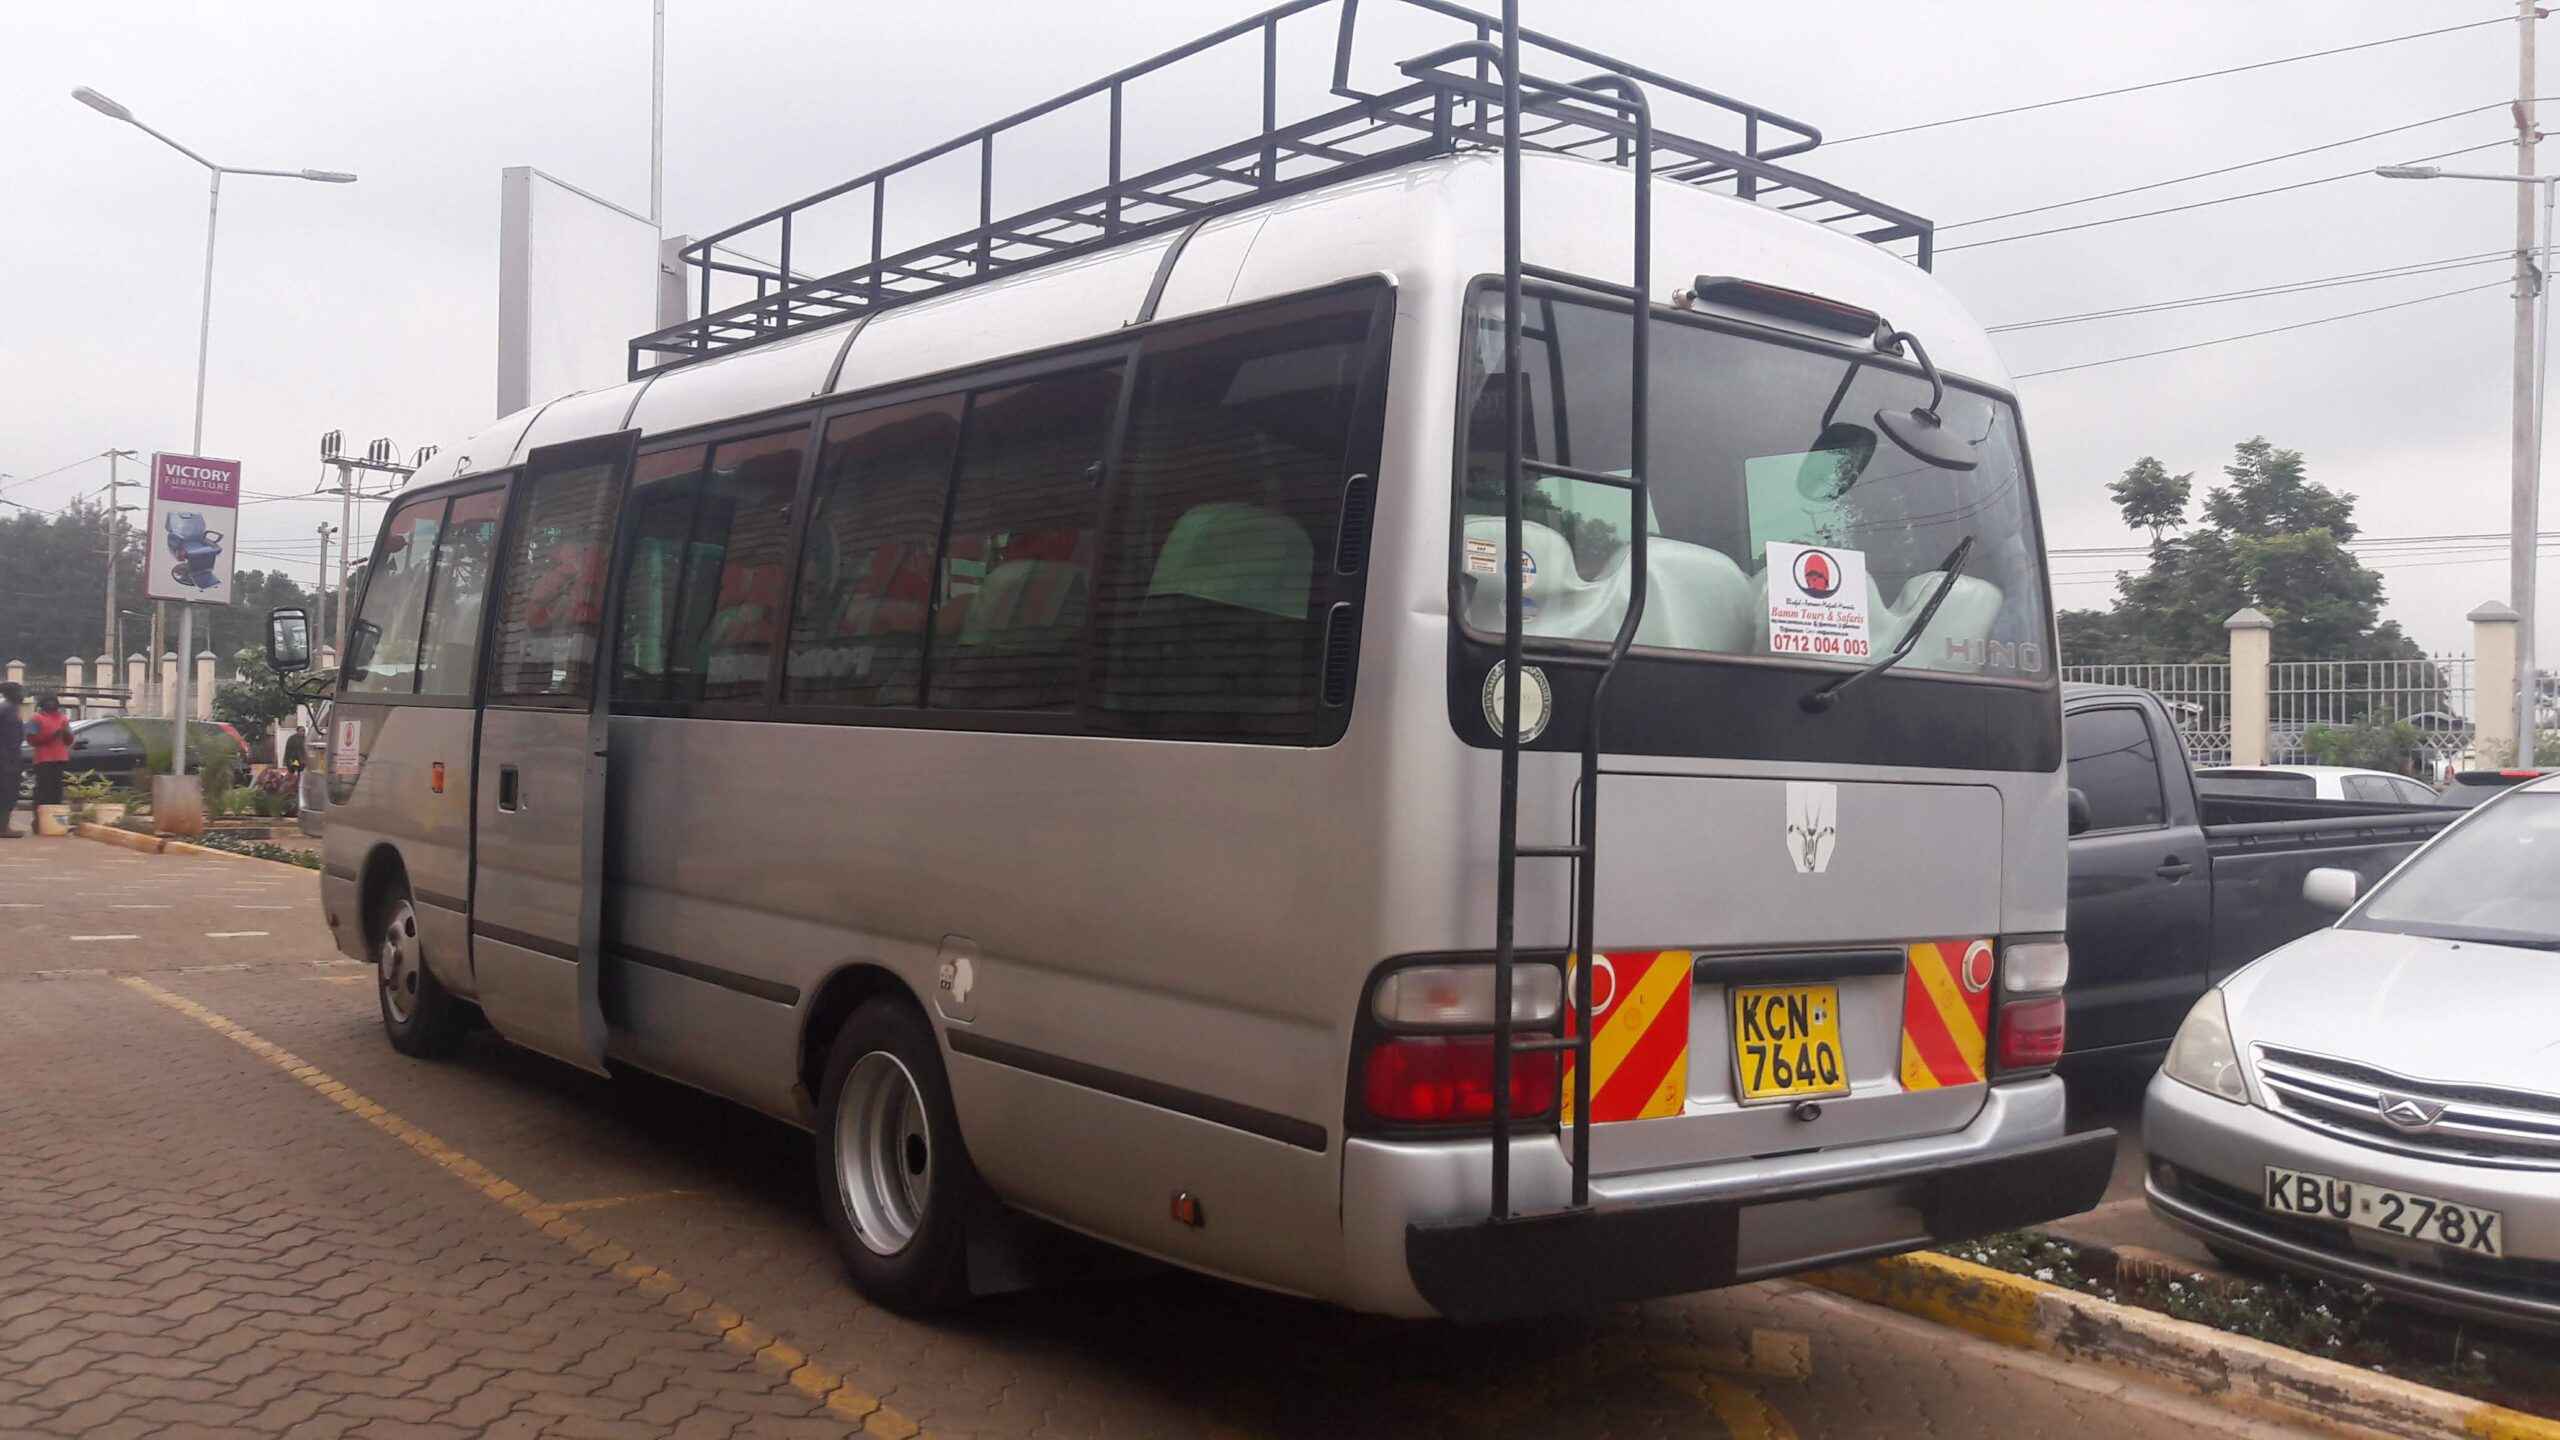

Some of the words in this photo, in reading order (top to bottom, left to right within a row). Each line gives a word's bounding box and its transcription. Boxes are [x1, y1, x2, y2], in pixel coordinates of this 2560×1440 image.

[164, 476, 230, 492] FURNITURE
[165, 463, 231, 482] VICTORY
[1801, 608, 1826, 621] Tours
[1774, 634, 1809, 652] 0712
[1814, 637, 1840, 653] 004
[1843, 639, 1869, 656] 003
[1945, 637, 2042, 672] HINO
[1742, 994, 1809, 1041] KCN
[1746, 1041, 1839, 1091] 764Q
[2268, 1170, 2352, 1220] KBU
[2378, 1193, 2497, 1254] 278X
